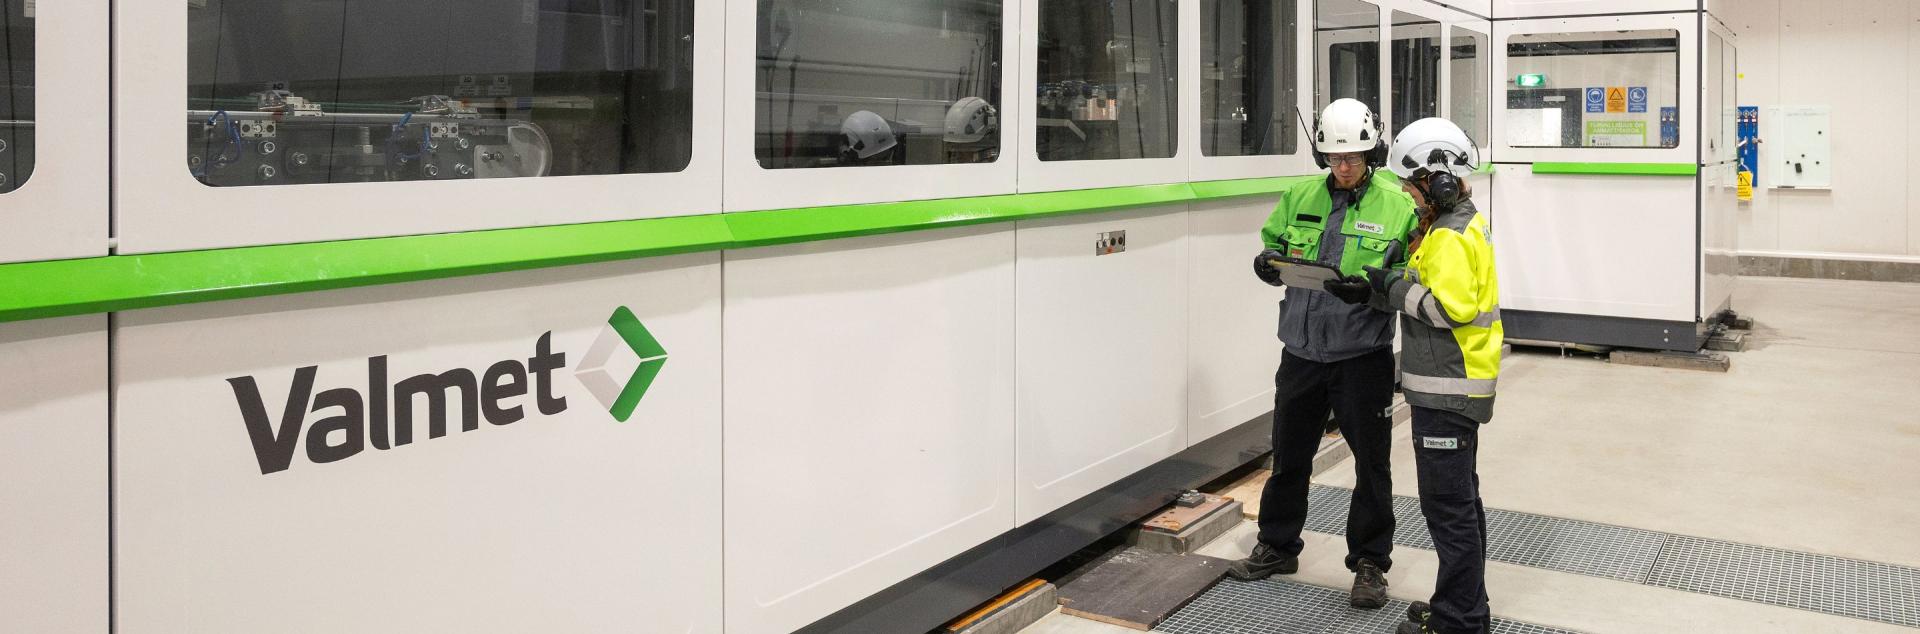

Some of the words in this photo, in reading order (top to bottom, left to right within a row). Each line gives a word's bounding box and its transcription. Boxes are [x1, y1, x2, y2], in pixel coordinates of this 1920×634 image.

[1356, 222, 1375, 231] Valmet
[225, 330, 568, 475] Valmet
[1424, 439, 1447, 447] Valmet
